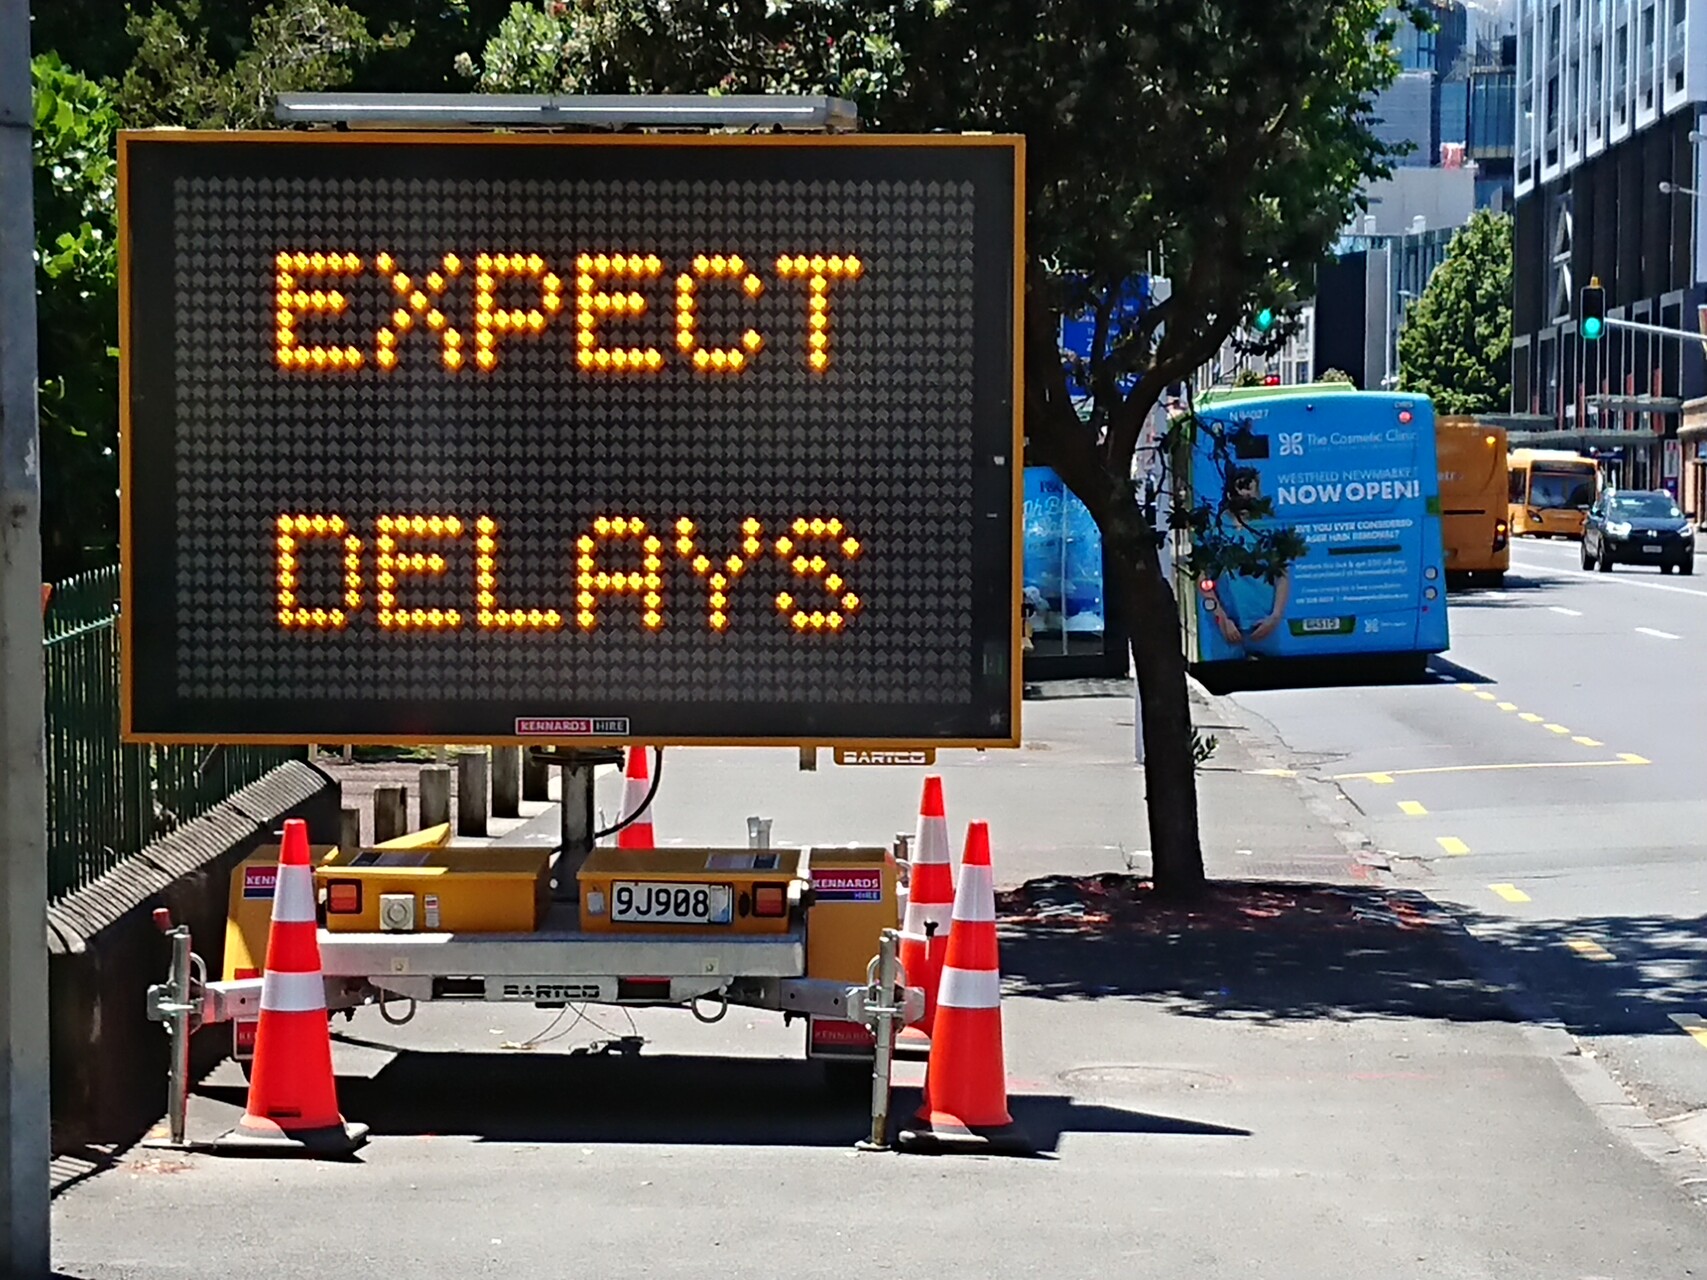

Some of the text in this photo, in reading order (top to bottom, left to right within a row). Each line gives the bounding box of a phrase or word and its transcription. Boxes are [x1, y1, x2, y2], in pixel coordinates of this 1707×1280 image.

[274, 251, 865, 373] EXPECT
[1307, 433, 1328, 446] The
[1330, 430, 1383, 445] Cosmetic
[1277, 466, 1419, 484] WESTFIELD NEWMARKET
[1277, 479, 1420, 505] NOW OPEN!
[1312, 522, 1332, 532] YOU
[276, 513, 862, 631] DELAYS
[520, 721, 624, 731] KENNARDS HIRE
[843, 751, 926, 763] BARTCO
[246, 875, 278, 885] KENN
[813, 878, 879, 888] KENNARDS
[854, 891, 878, 899] HIRE
[616, 887, 709, 917] 9J908
[503, 984, 600, 998] BARTCO
[815, 1030, 874, 1039] KENNARD
